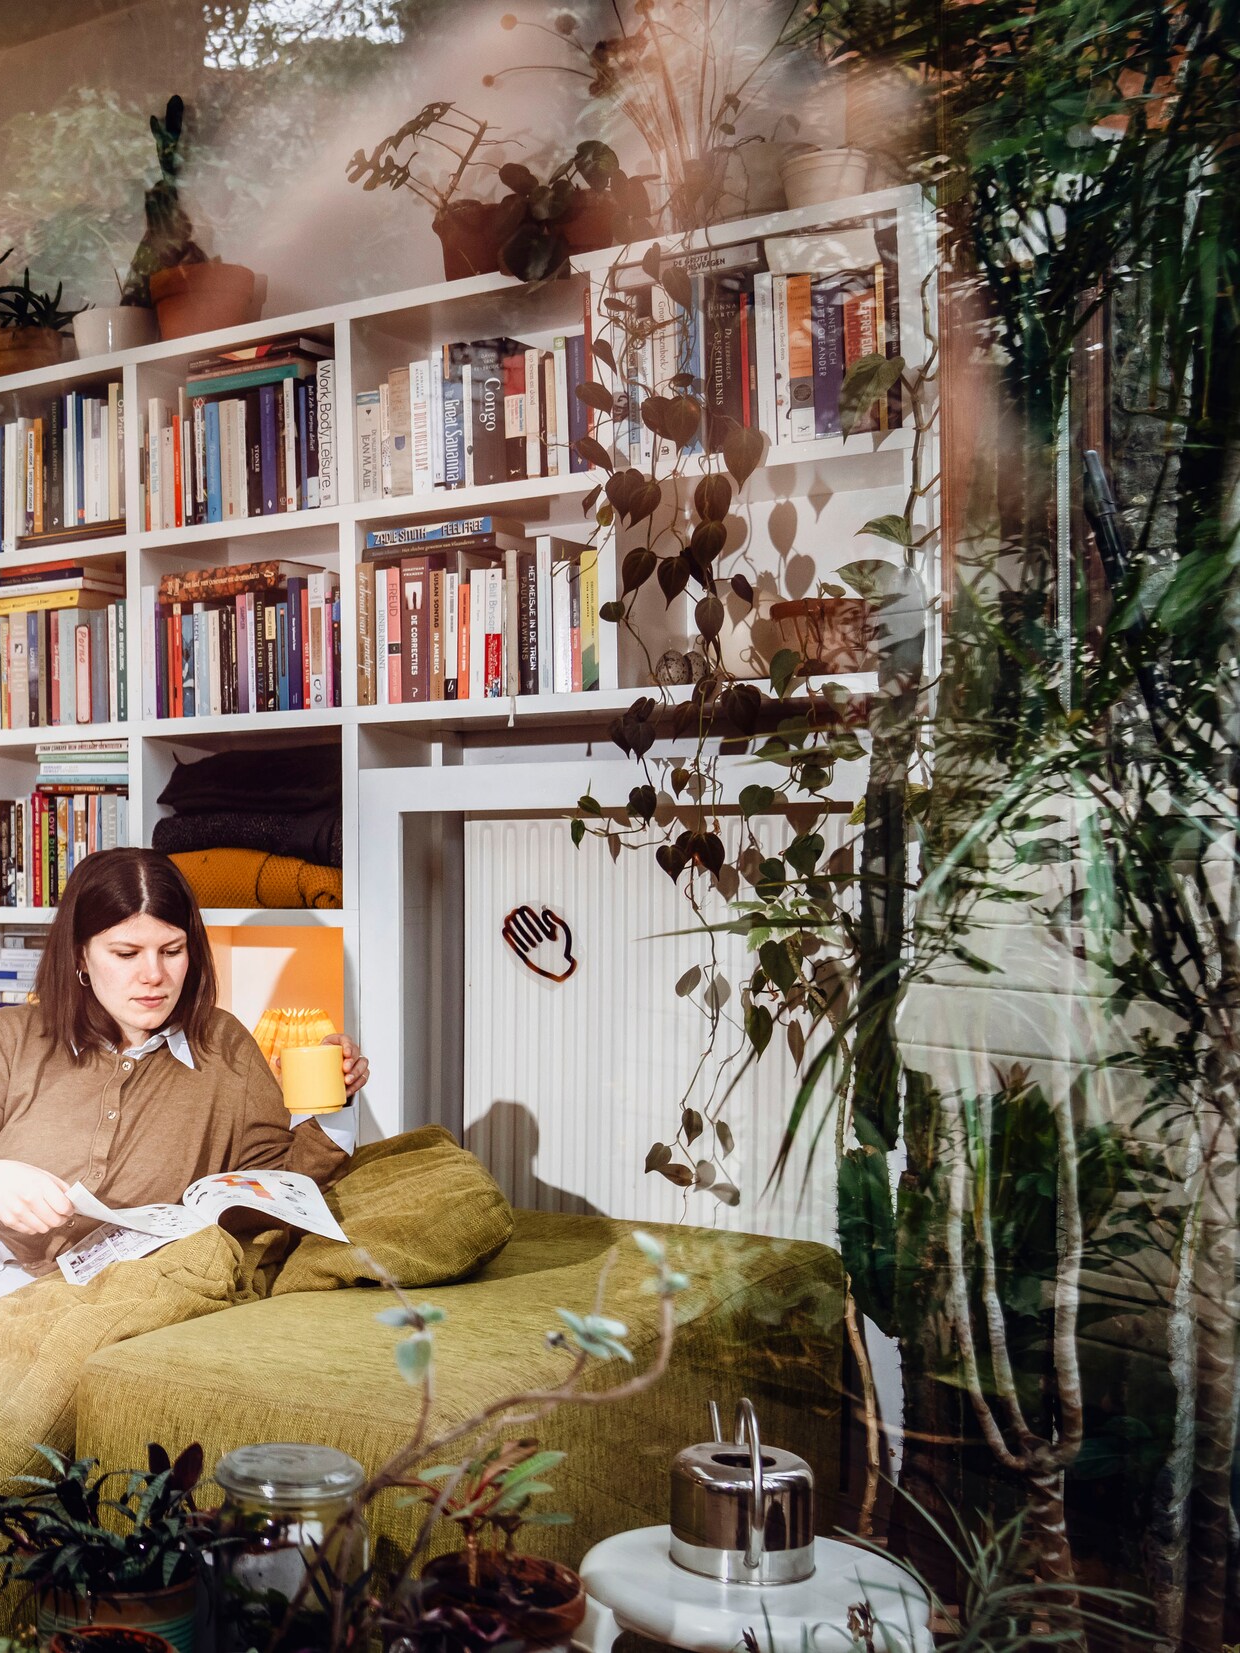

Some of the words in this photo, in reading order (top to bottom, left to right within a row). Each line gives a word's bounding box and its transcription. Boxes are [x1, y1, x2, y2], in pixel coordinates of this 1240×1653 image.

[829, 306, 837, 335] JANET
[818, 327, 828, 377] OLEANDER
[829, 339, 838, 365] FITCH
[117, 399, 125, 414] On
[444, 399, 461, 430] Great
[478, 378, 501, 432] Congo
[117, 415, 125, 440] Pride
[360, 434, 370, 454] JEAN
[321, 442, 334, 491] Leisure.
[361, 455, 371, 467] M.
[361, 468, 371, 490] AUEL
[441, 523, 461, 536] FEEL
[462, 520, 483, 533] FREE
[358, 572, 368, 585] de
[487, 583, 498, 599] Bill
[256, 601, 264, 621] toni
[359, 585, 371, 615] draad
[388, 583, 398, 617] FREUD
[528, 585, 536, 616] MEISJE
[359, 617, 367, 634] van
[410, 615, 417, 626] DE
[487, 600, 498, 632] Bryson
[78, 630, 87, 664] Porno
[256, 623, 264, 668] morrison
[521, 614, 529, 661] HAWKINS
[529, 631, 536, 642] DE
[357, 636, 373, 679] penelope
[410, 627, 418, 676] CORRECTIES
[529, 645, 537, 671] TREIN
